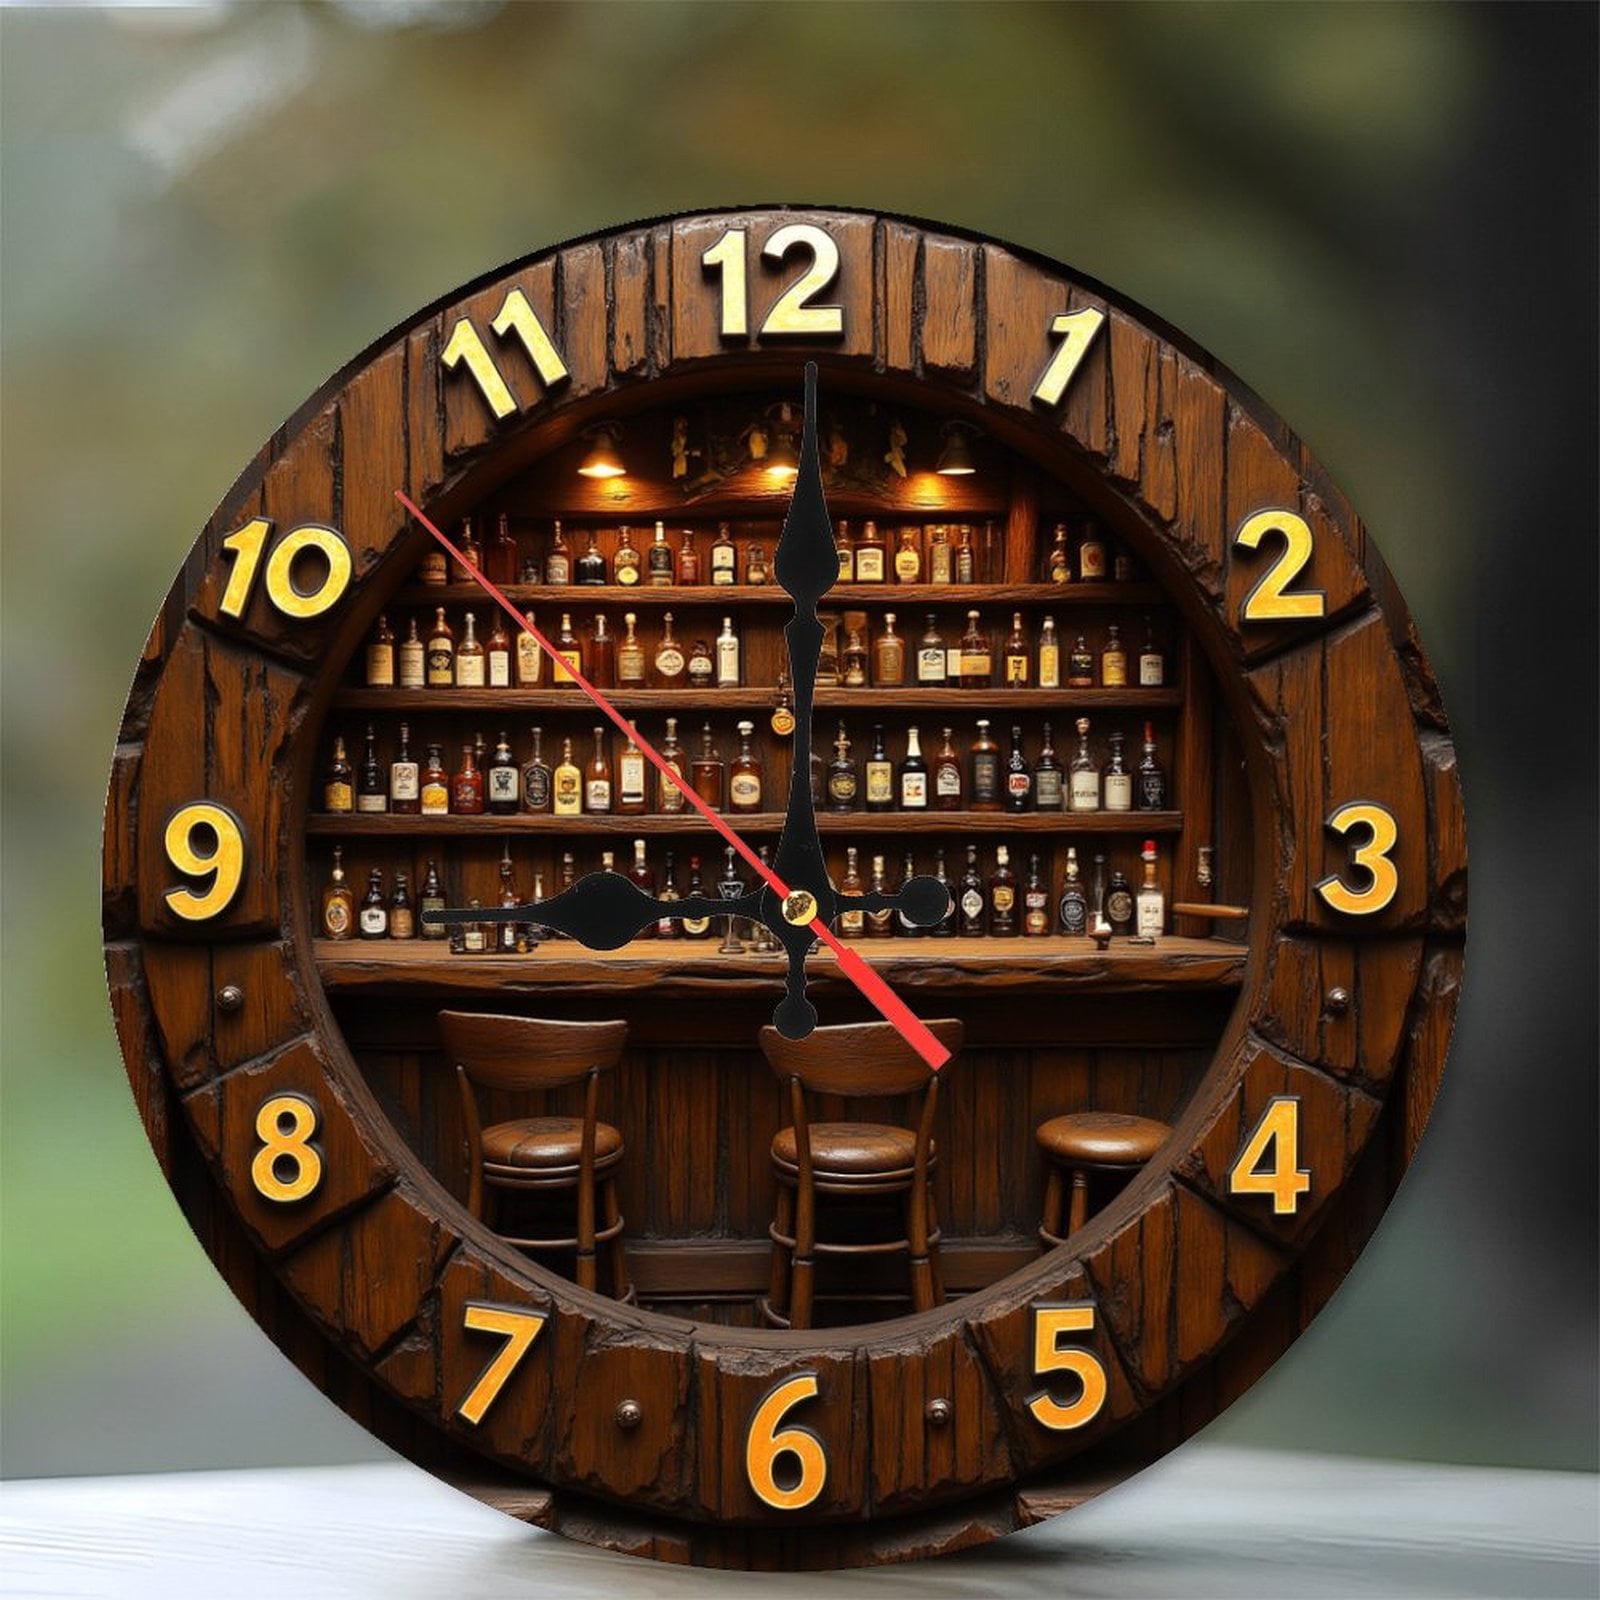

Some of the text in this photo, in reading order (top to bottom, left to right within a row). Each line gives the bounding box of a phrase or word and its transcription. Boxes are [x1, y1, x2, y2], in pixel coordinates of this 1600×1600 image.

[702, 224, 845, 336] 12
[440, 289, 569, 420] 11
[1033, 307, 1106, 408] 1
[220, 518, 353, 620] 10
[1235, 510, 1326, 621] 2
[164, 803, 245, 922] 9
[1318, 803, 1399, 915] 3
[250, 1094, 323, 1203] 8
[1229, 1098, 1311, 1215] 4
[459, 1304, 547, 1425] 7
[1028, 1305, 1108, 1432] 5
[746, 1374, 828, 1510] 6
